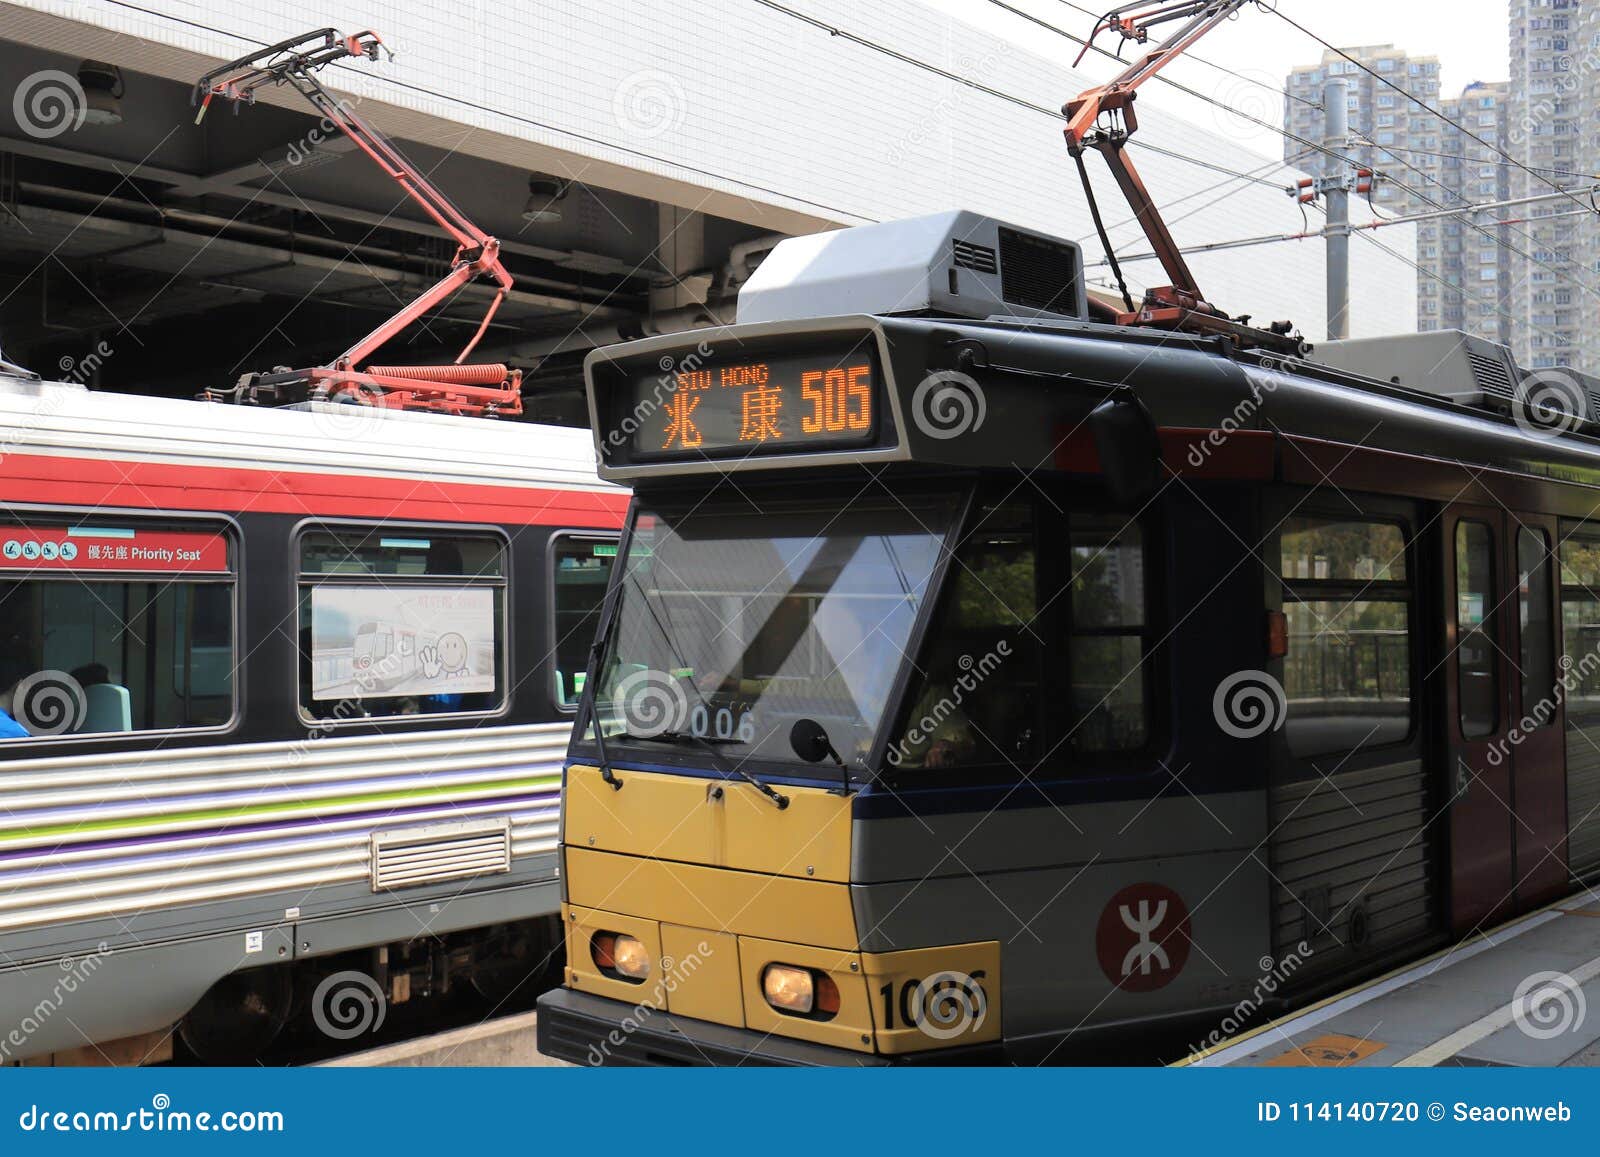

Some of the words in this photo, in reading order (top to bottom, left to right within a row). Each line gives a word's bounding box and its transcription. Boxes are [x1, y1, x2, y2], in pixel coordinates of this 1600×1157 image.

[677, 370, 712, 391] SIU
[721, 364, 769, 388] HONG
[801, 365, 870, 433] 505
[87, 544, 128, 560] 優先座
[131, 548, 173, 563] Priority
[176, 549, 202, 561] Seat
